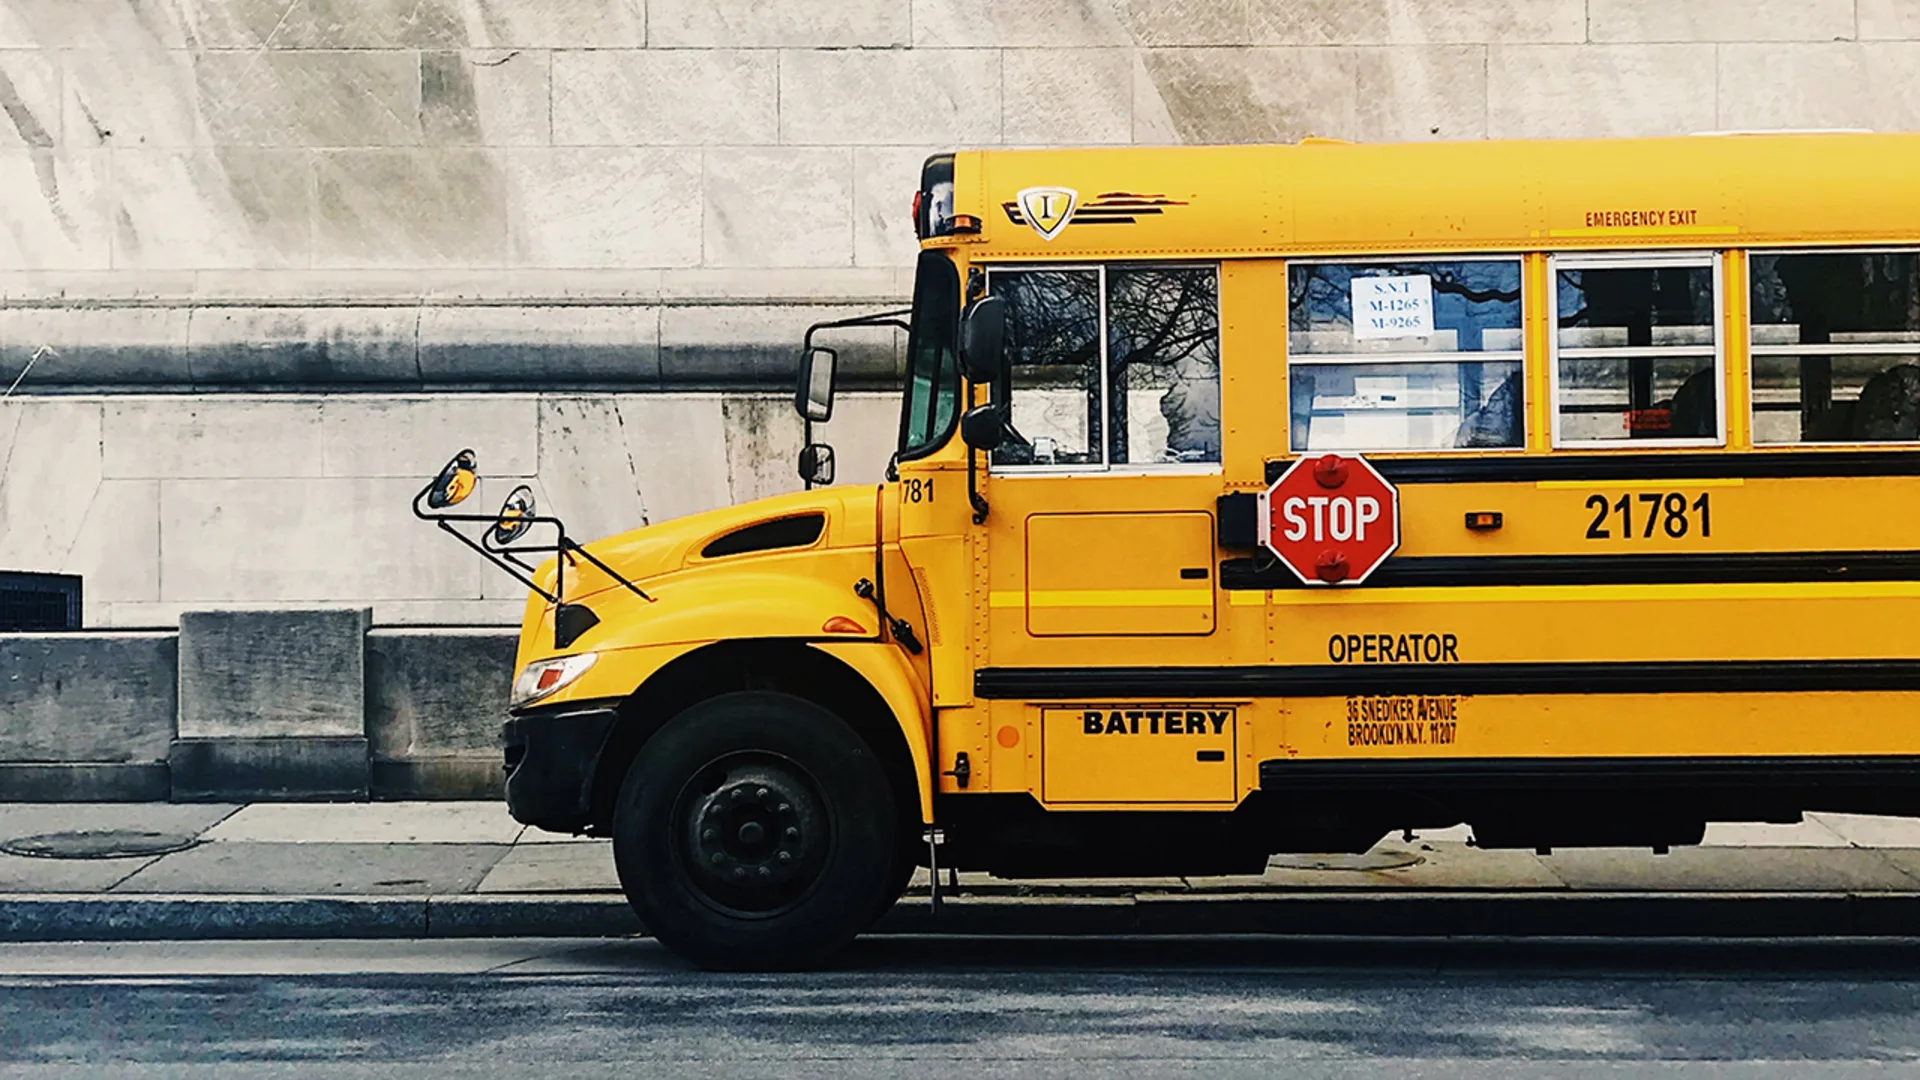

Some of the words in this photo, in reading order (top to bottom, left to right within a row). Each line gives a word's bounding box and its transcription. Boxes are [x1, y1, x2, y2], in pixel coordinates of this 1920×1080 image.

[1585, 210, 1665, 227] EMERGENCY
[1668, 209, 1697, 226] EXIT
[1369, 298, 1420, 312] M-1265
[1371, 315, 1422, 329] M-9265
[903, 478, 934, 504] 781
[1283, 496, 1380, 542] STOP
[1585, 492, 1710, 539] 21781
[1328, 633, 1459, 663] OPERATOR
[1347, 700, 1359, 722] 36
[1361, 699, 1414, 722] SNEDIKER
[1417, 698, 1457, 721] AVENUE
[1083, 711, 1229, 734] BATTERY
[1348, 723, 1403, 746] BROOKLYN
[1430, 722, 1456, 744] 11207
